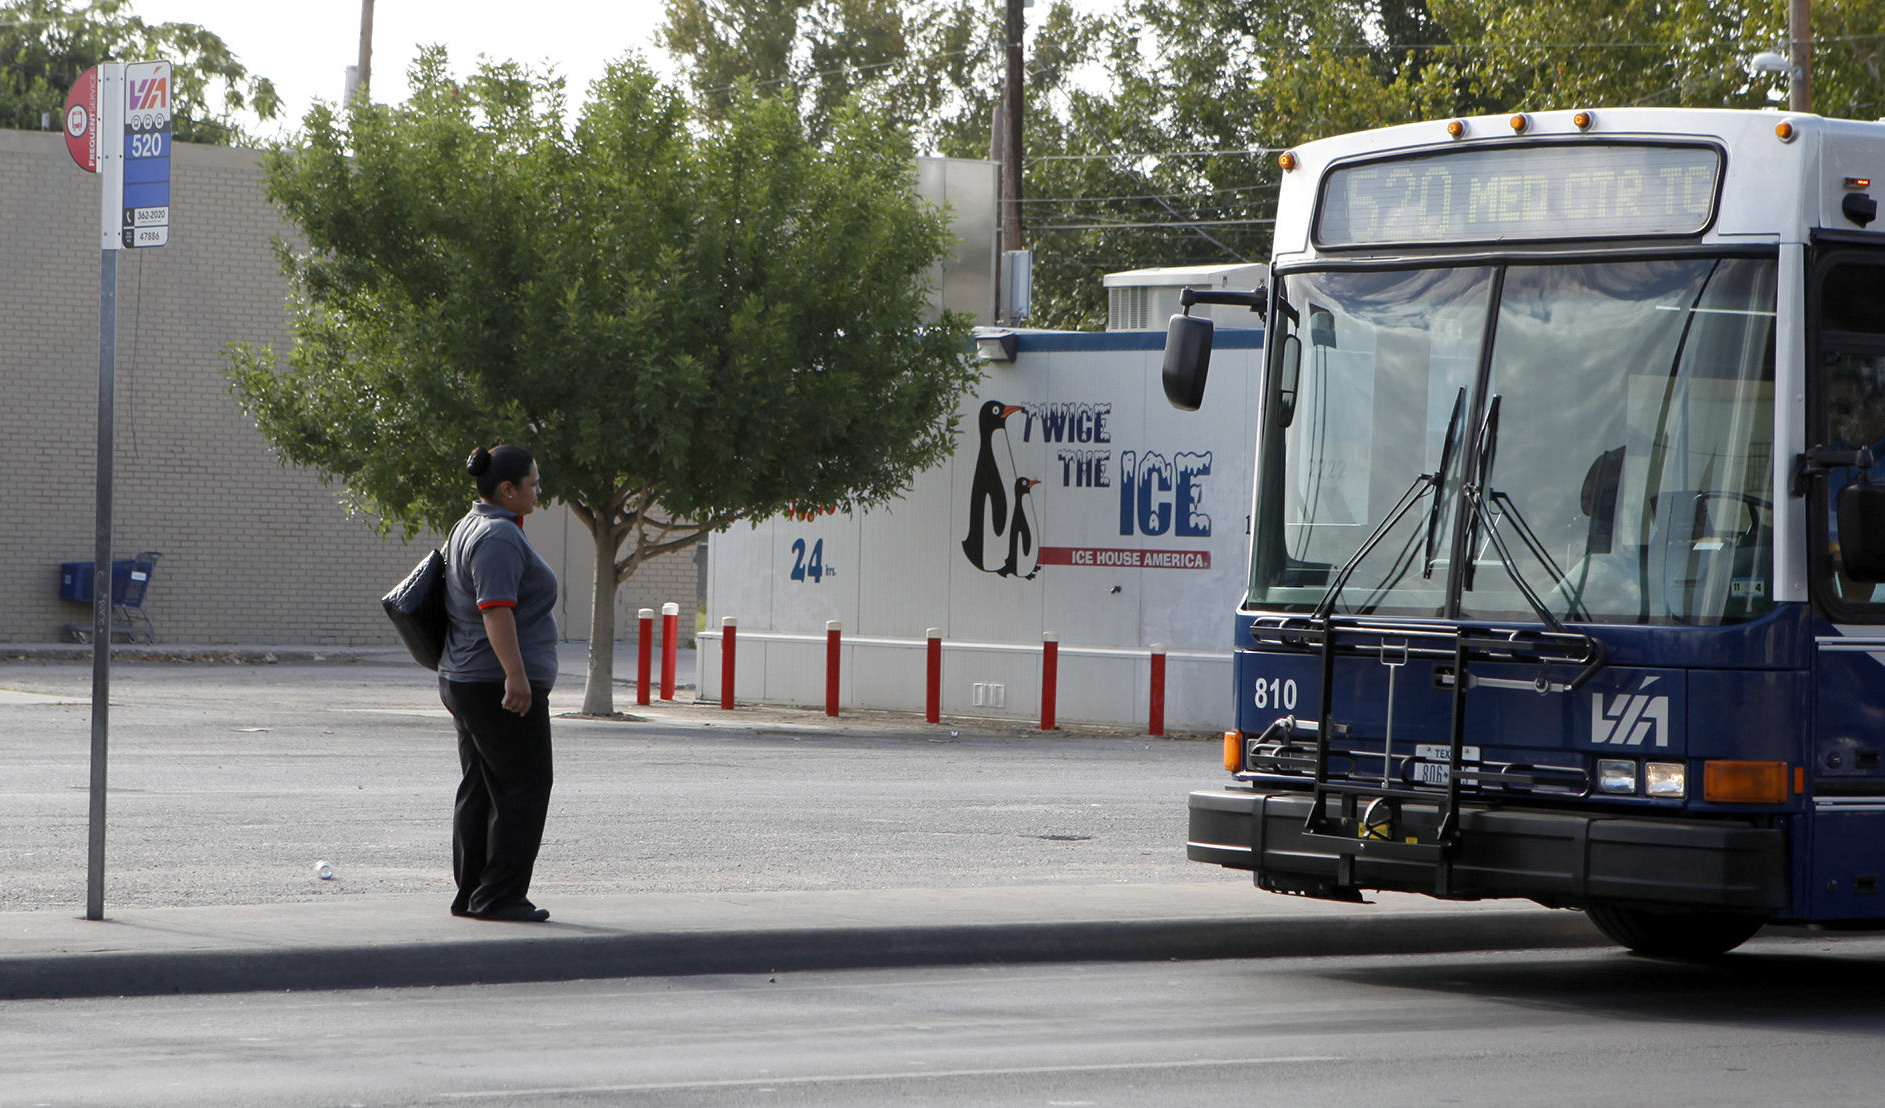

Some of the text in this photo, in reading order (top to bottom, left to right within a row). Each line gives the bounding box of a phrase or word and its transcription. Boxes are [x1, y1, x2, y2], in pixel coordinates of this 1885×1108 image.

[132, 133, 162, 157] 520
[1347, 166, 1452, 239] 520
[1469, 175, 1548, 223] MED
[1565, 168, 1642, 219] CTR
[1020, 402, 1112, 443] TWICE
[1058, 449, 1111, 487] THE
[1119, 450, 1213, 537] ICE
[790, 538, 823, 583] 24
[1072, 551, 1094, 565] ICE
[1096, 551, 1141, 566] HOUSE
[1254, 677, 1298, 710] 810
